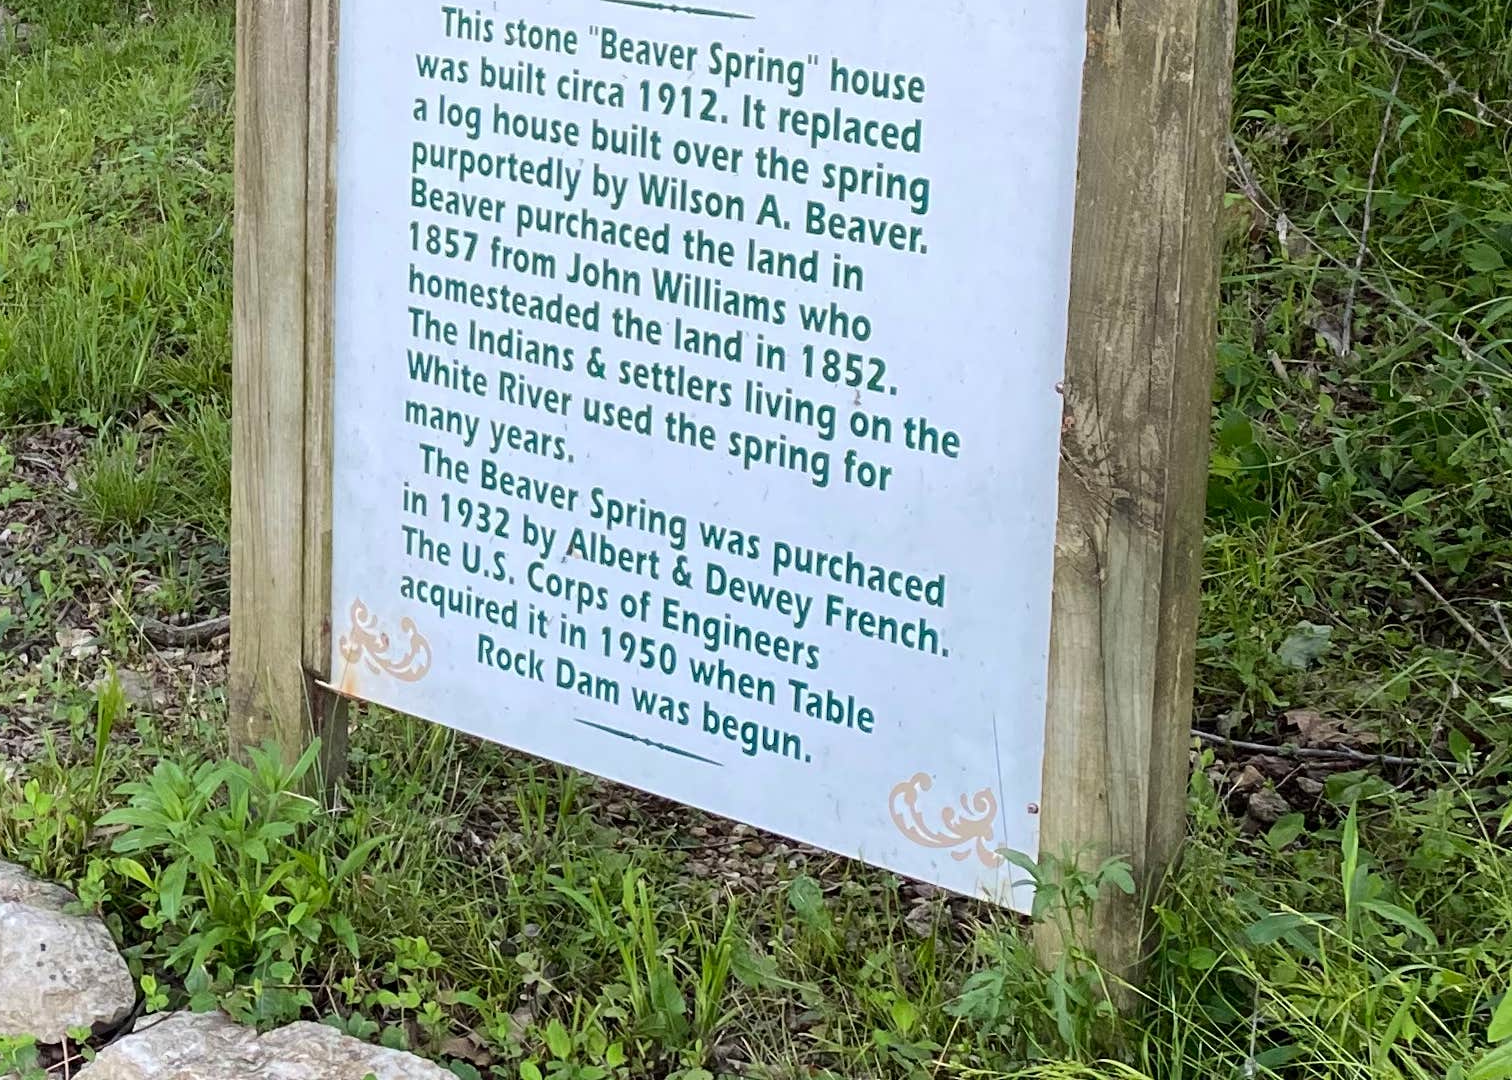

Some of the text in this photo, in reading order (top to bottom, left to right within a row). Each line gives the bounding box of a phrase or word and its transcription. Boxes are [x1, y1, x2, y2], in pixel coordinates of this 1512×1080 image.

[415, 53, 921, 153] was built circa 1912. It replaced
[441, 6, 925, 103] This stone "Beaver Spring" house
[412, 141, 926, 254] purportedly by Wilson A. Beaver.
[413, 94, 929, 215] a log house built over the spring
[409, 220, 871, 341] 1857 from John Williams who
[411, 176, 863, 291] Beaver purchaced the land in
[407, 306, 960, 458] The Indians & settlers living on the
[409, 262, 896, 395] homesteaded the land in 1852.
[405, 400, 573, 463] many years.
[407, 349, 892, 491] White River used the spring for
[403, 481, 948, 657] in 1932 by Albert & Dewey French.
[419, 442, 944, 607] The Beaver Spring was purchaced
[400, 575, 874, 733] acquired it in 1950 when Table
[401, 524, 819, 669] The U.S. Corps of Engineers
[477, 633, 810, 763] Rock Dam was begun.
